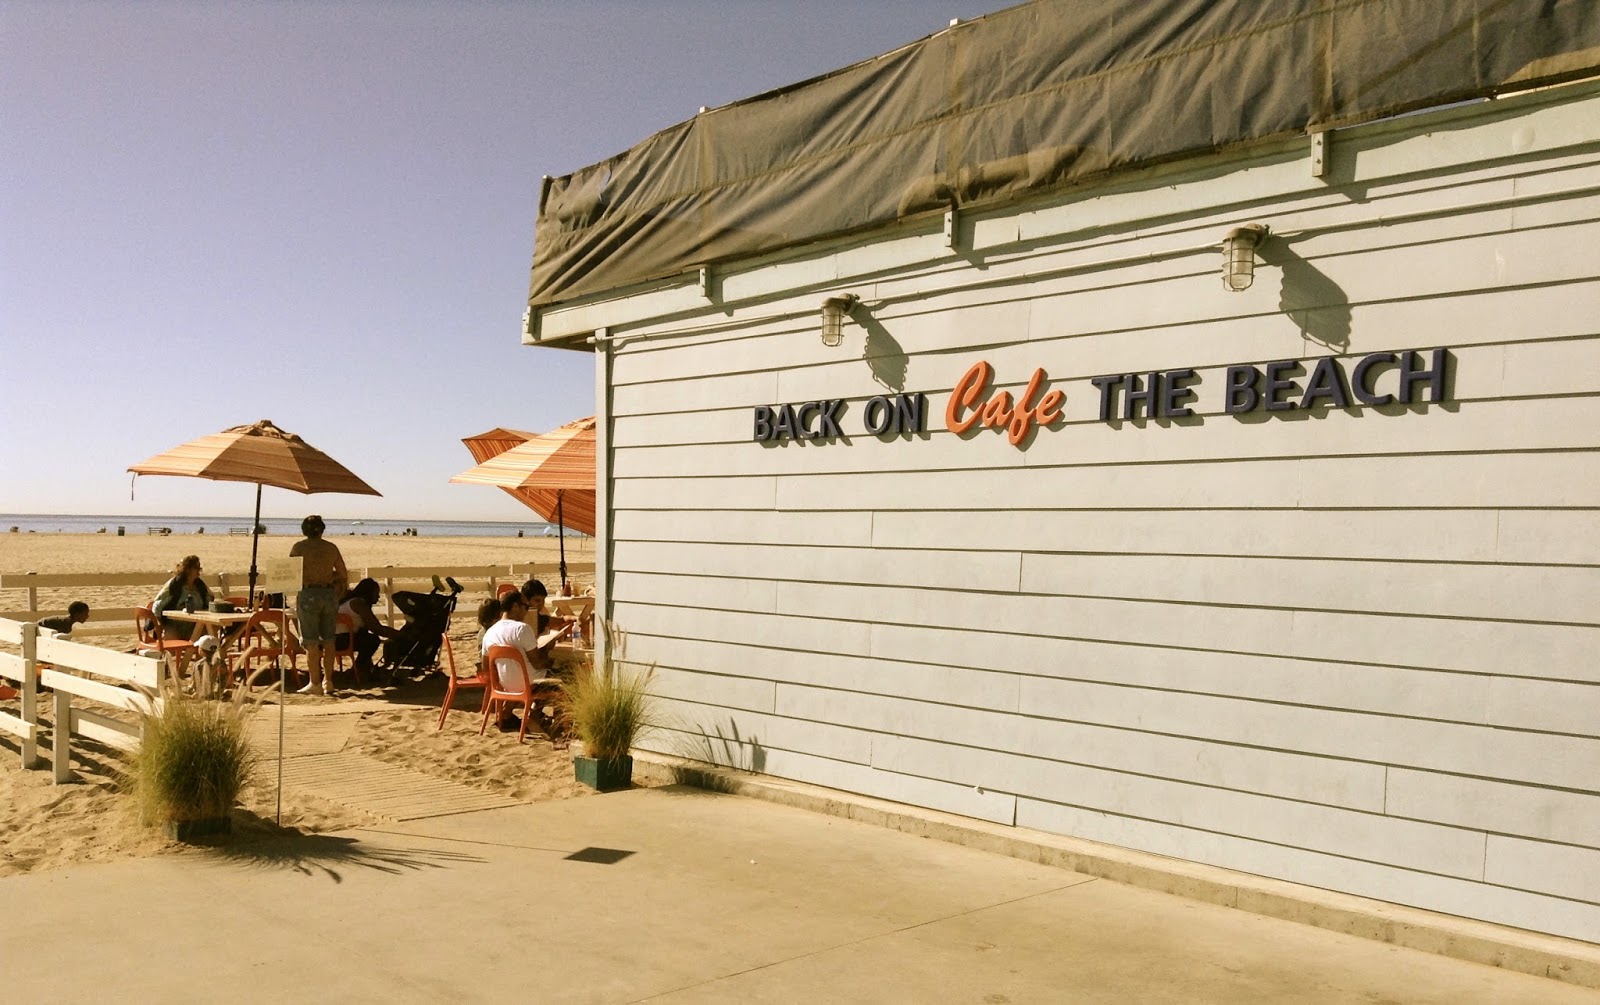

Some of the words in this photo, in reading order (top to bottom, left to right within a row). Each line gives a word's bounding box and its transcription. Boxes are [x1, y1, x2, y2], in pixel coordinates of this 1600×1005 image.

[753, 399, 842, 441] BACK
[864, 392, 923, 435] ON
[945, 360, 1065, 446] Cafe
[1091, 369, 1194, 421] THE
[1224, 348, 1449, 414] BEACH
